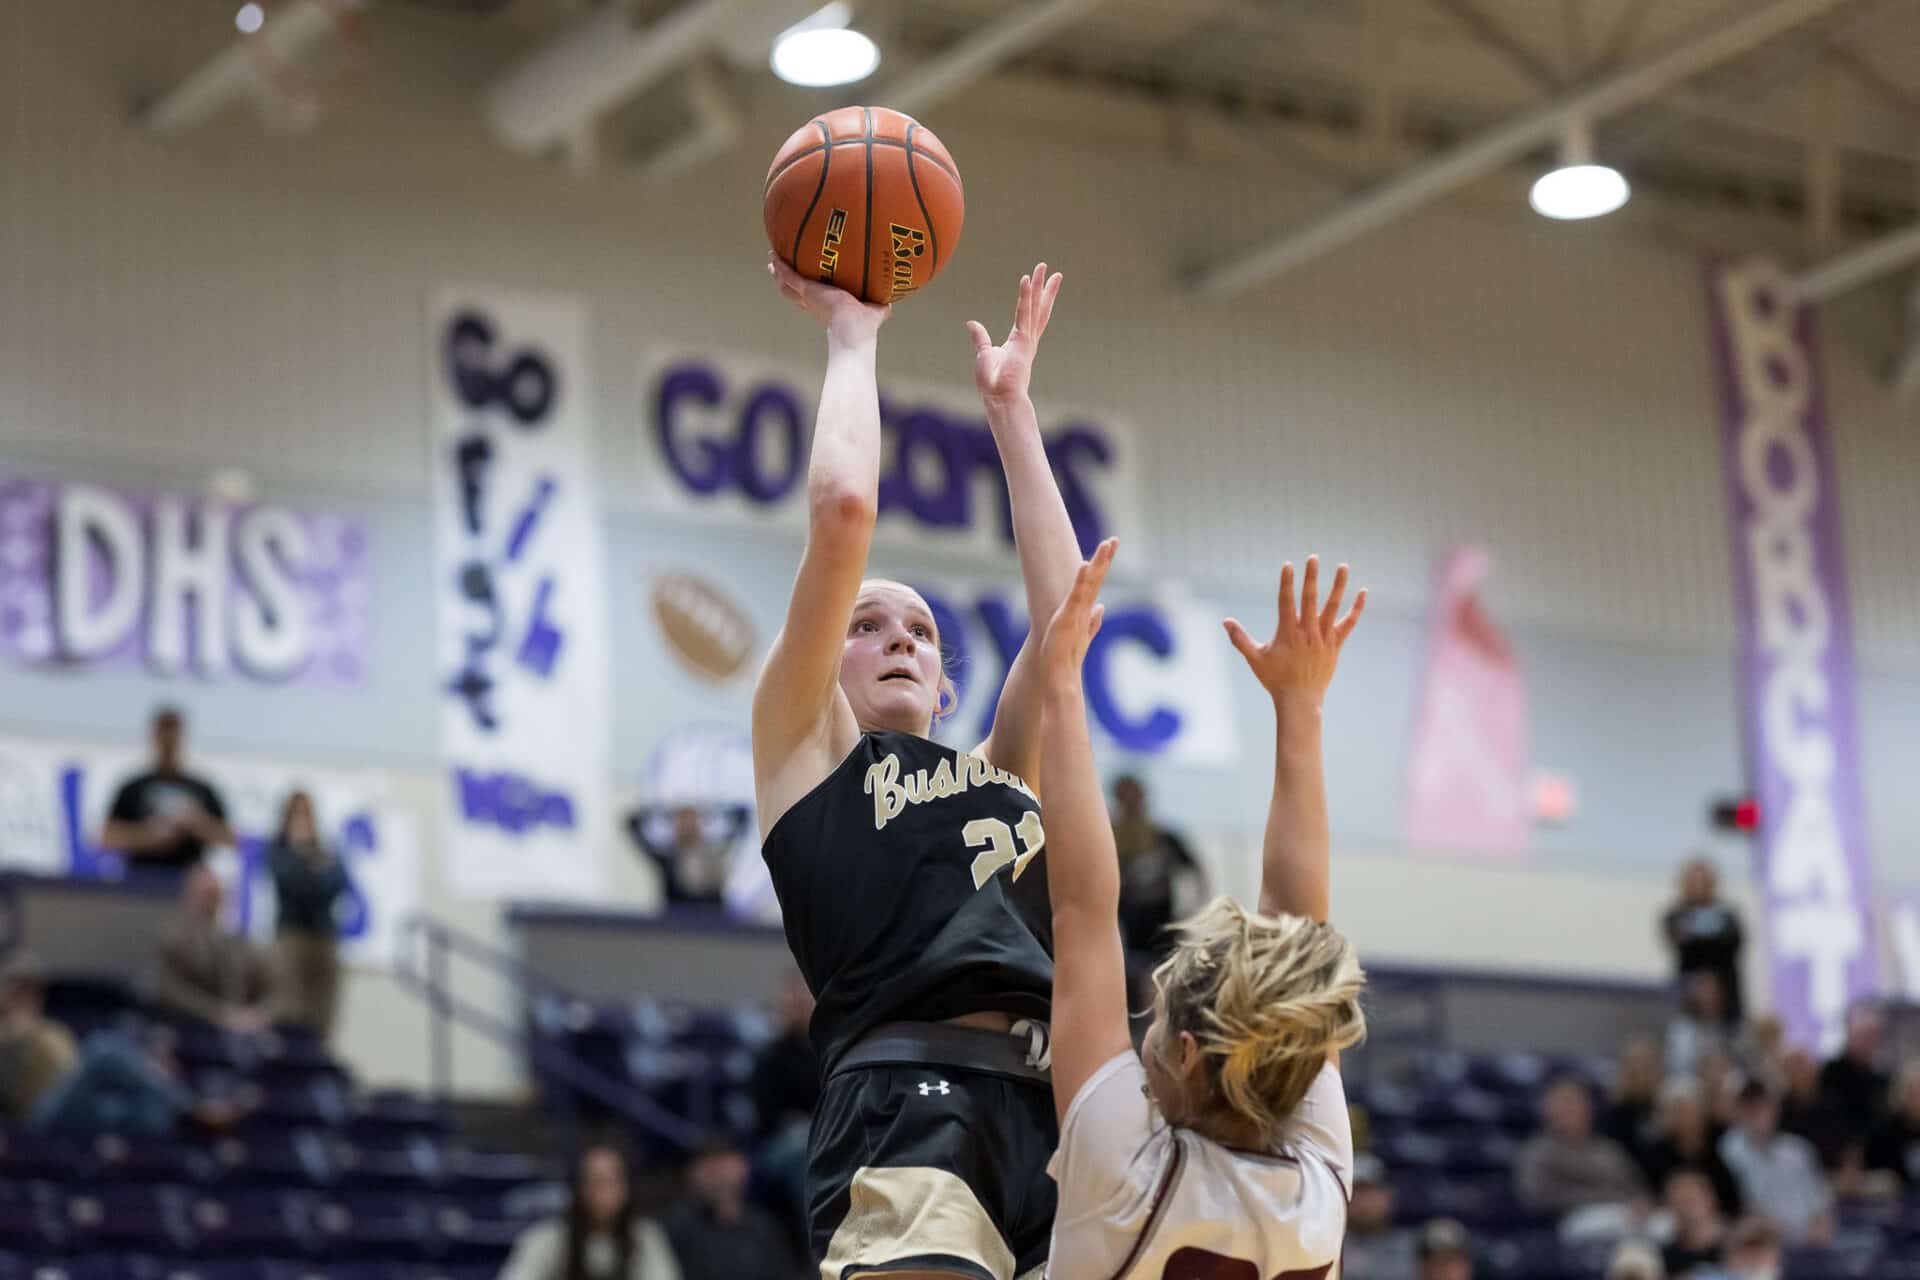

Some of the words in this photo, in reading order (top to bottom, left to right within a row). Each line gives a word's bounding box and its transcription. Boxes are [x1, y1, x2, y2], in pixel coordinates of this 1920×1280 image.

[889, 222, 926, 300] Bad
[56, 482, 310, 684] DHS
[1724, 262, 1864, 1055] BOBCAT
